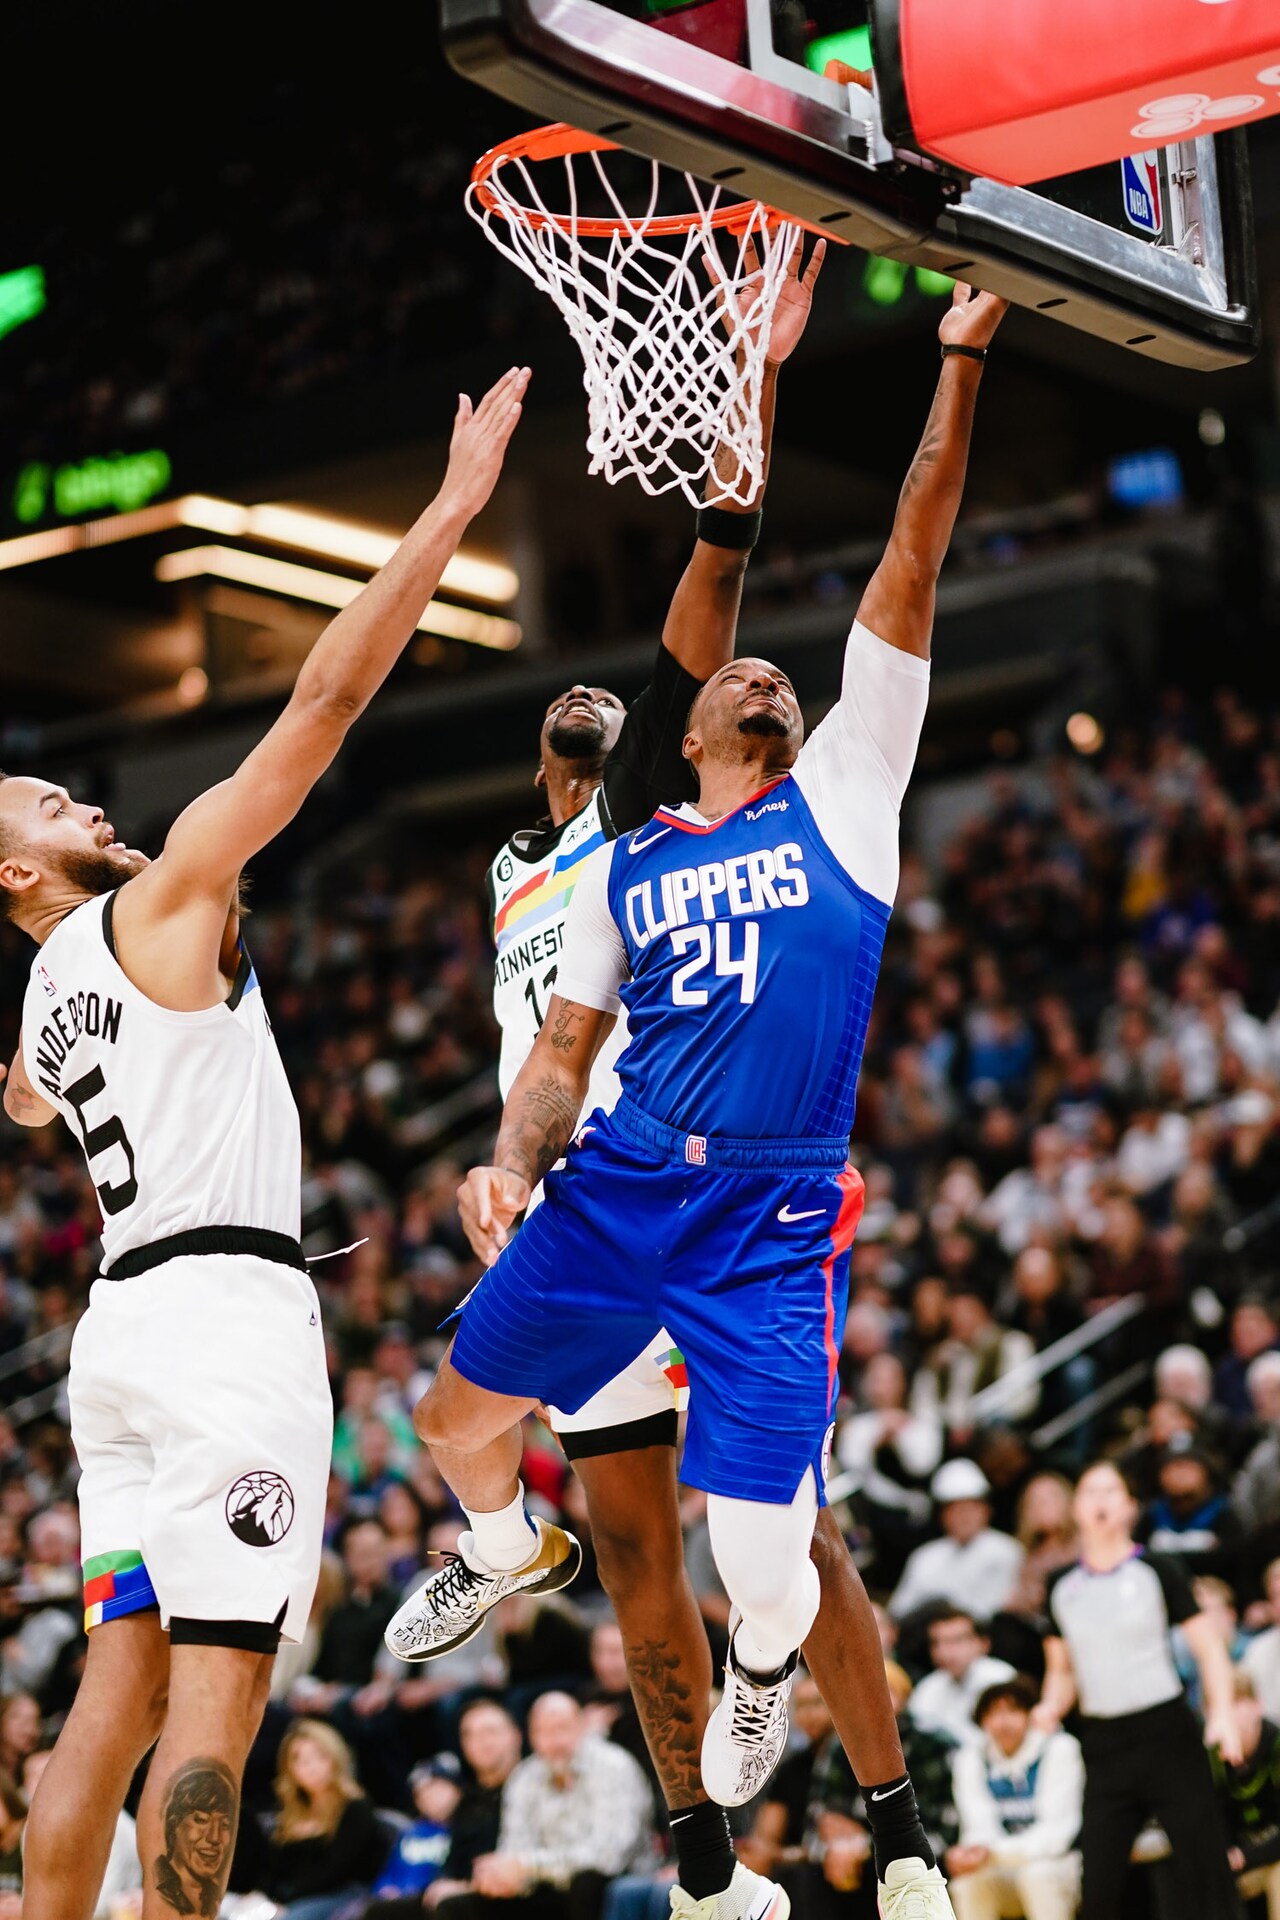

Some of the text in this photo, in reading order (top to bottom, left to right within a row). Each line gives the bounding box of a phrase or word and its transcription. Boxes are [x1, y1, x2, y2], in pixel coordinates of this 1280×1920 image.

[1129, 188, 1149, 219] NBA
[744, 799, 789, 821] honey
[625, 842, 810, 949] CLIPPERS
[669, 921, 760, 1006] 24
[36, 991, 123, 1101] ANDERSON
[62, 1063, 139, 1216] 5
